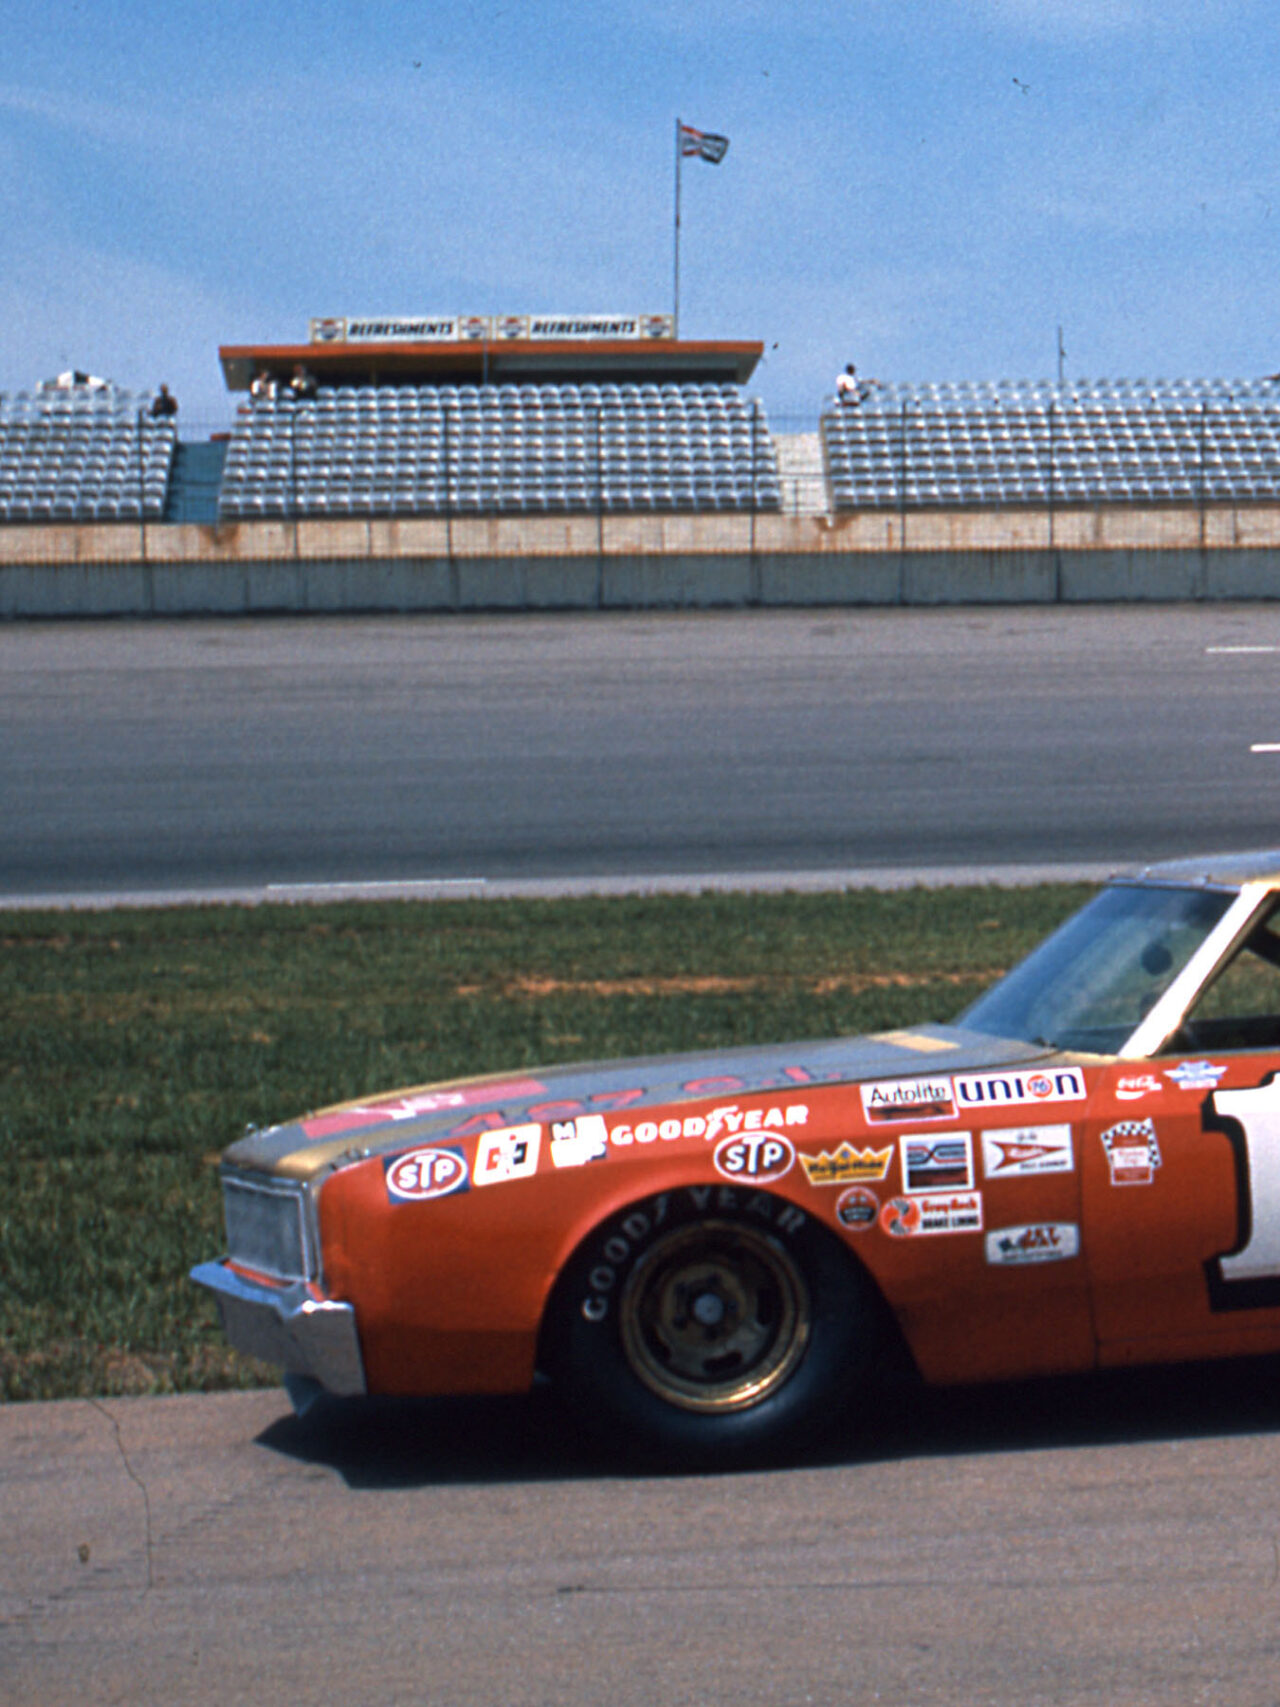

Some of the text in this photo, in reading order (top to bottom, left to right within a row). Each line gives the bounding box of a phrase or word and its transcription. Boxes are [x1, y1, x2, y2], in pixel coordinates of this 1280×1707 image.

[350, 321, 454, 336] REFRESHMENTS
[532, 320, 637, 334] REFRESHMENTS
[870, 1083, 946, 1105] Autolite
[611, 1105, 809, 1141] GOODYEAR
[725, 1136, 784, 1173] STP
[399, 1154, 455, 1188] STP
